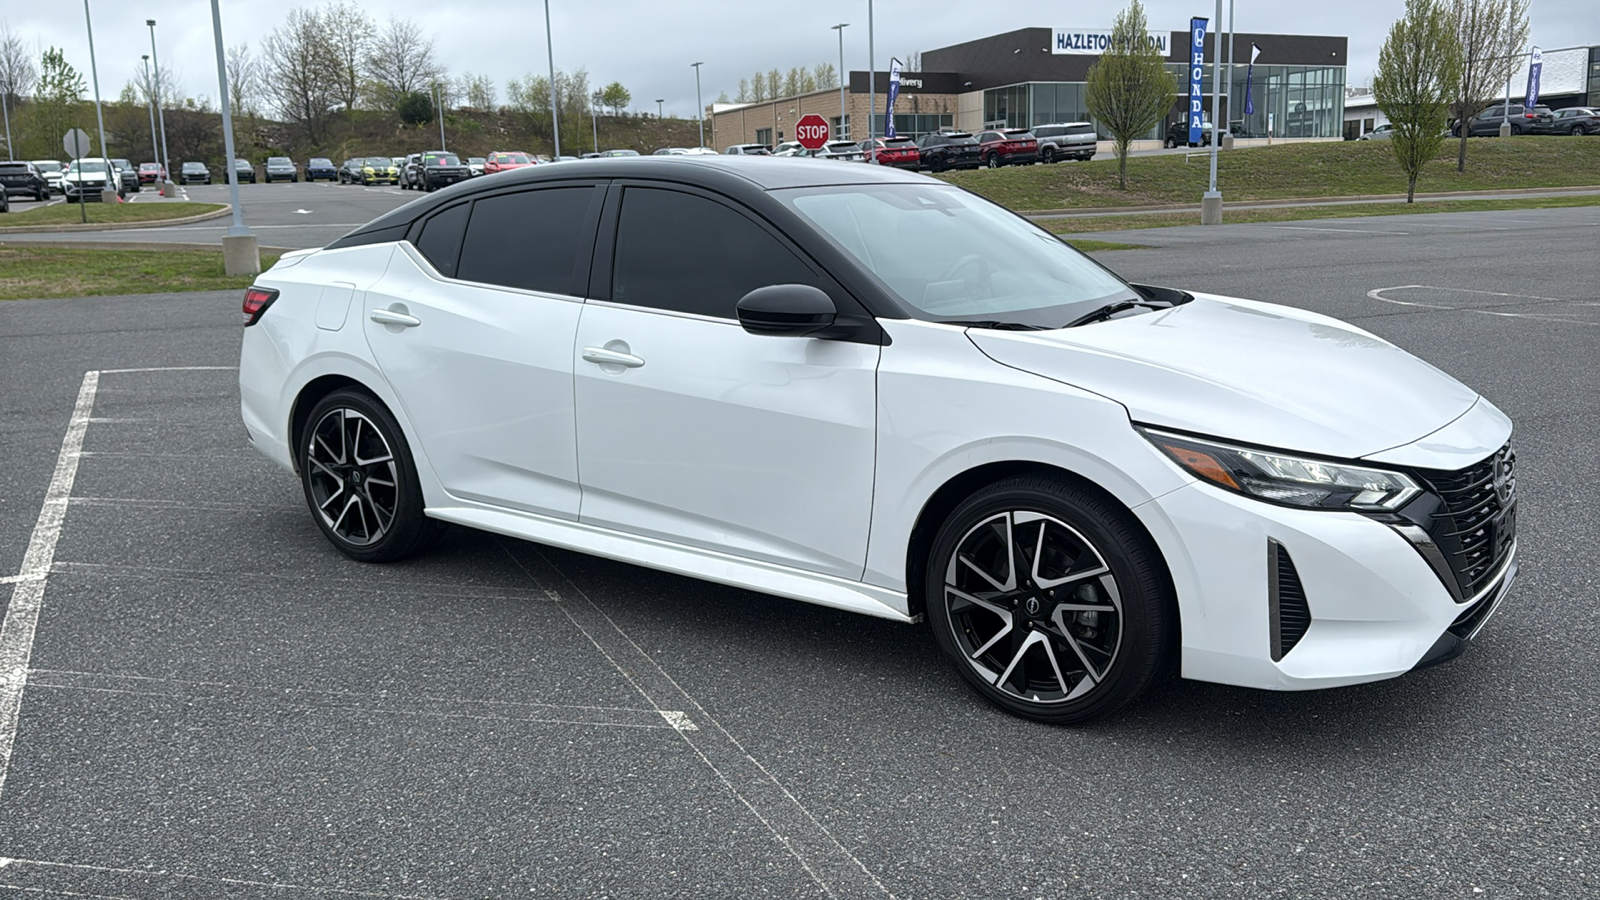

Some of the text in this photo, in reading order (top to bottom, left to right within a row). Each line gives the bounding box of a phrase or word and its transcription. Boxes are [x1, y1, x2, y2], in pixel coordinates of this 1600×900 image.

[1057, 33, 1115, 51] HAZLETON
[1191, 53, 1204, 128] HONDA
[798, 125, 828, 139] STOP
